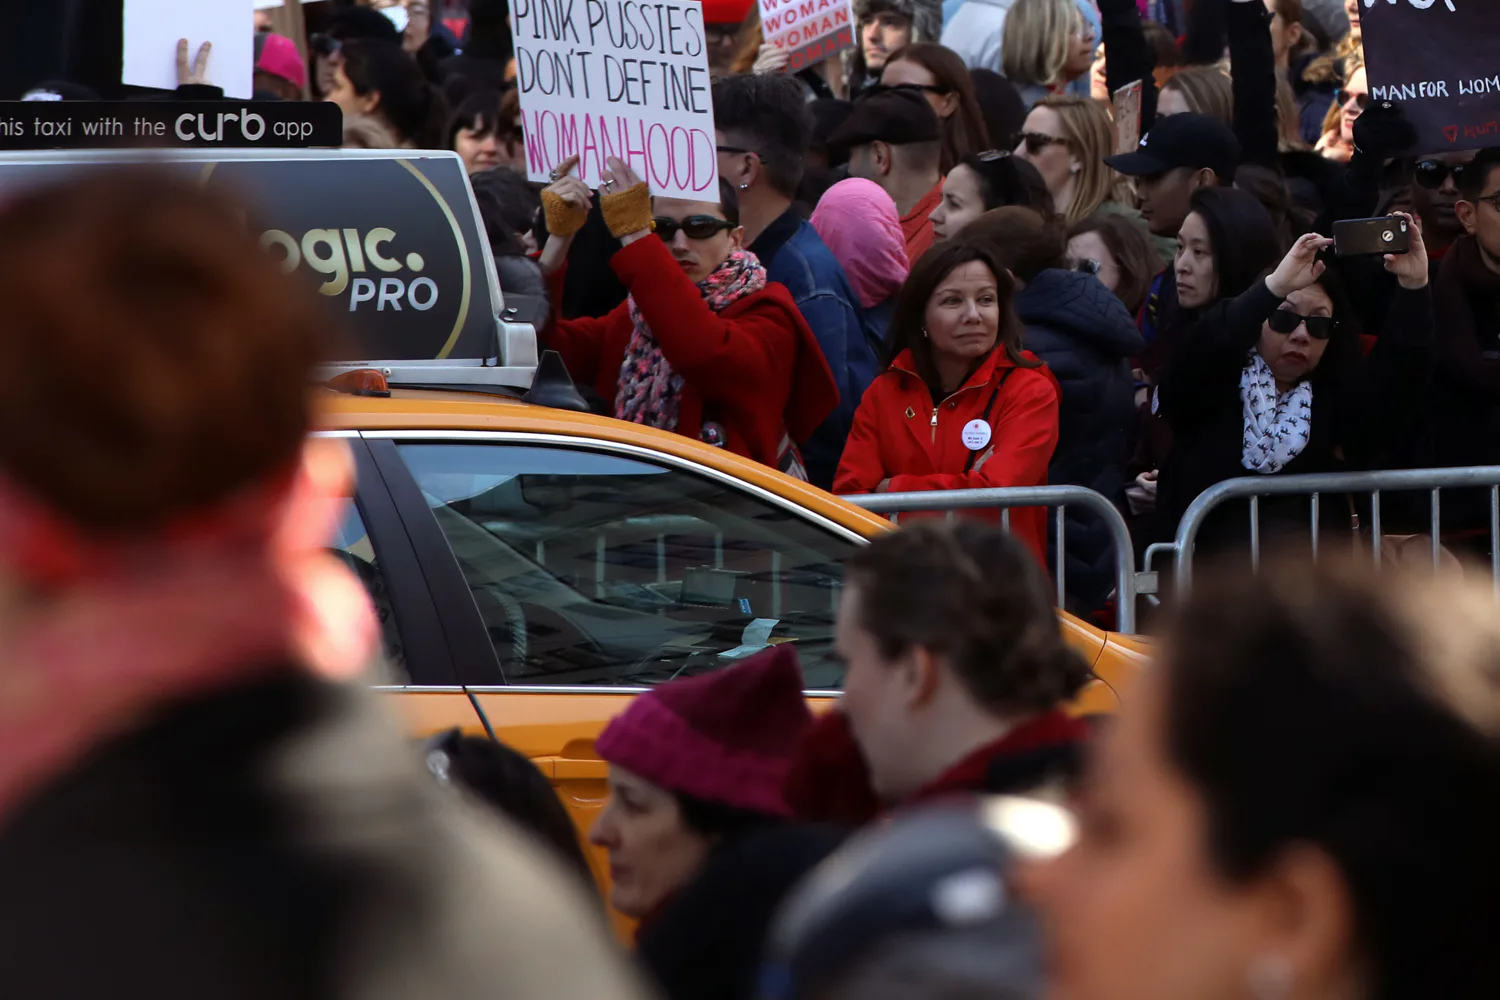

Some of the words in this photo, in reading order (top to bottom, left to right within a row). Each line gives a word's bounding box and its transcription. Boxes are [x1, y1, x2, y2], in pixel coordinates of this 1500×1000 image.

[783, 29, 852, 72] OMAN
[517, 46, 592, 99] DON'T
[604, 55, 708, 113] DEFINE
[1372, 83, 1417, 100] MAN
[1418, 80, 1449, 98] FOR
[34, 117, 72, 136] taxi
[82, 117, 123, 136] with
[134, 117, 166, 136] the
[174, 108, 267, 142] curb
[273, 120, 314, 140] app
[520, 108, 715, 191] WOMANHOOD
[349, 276, 439, 312] PRO
